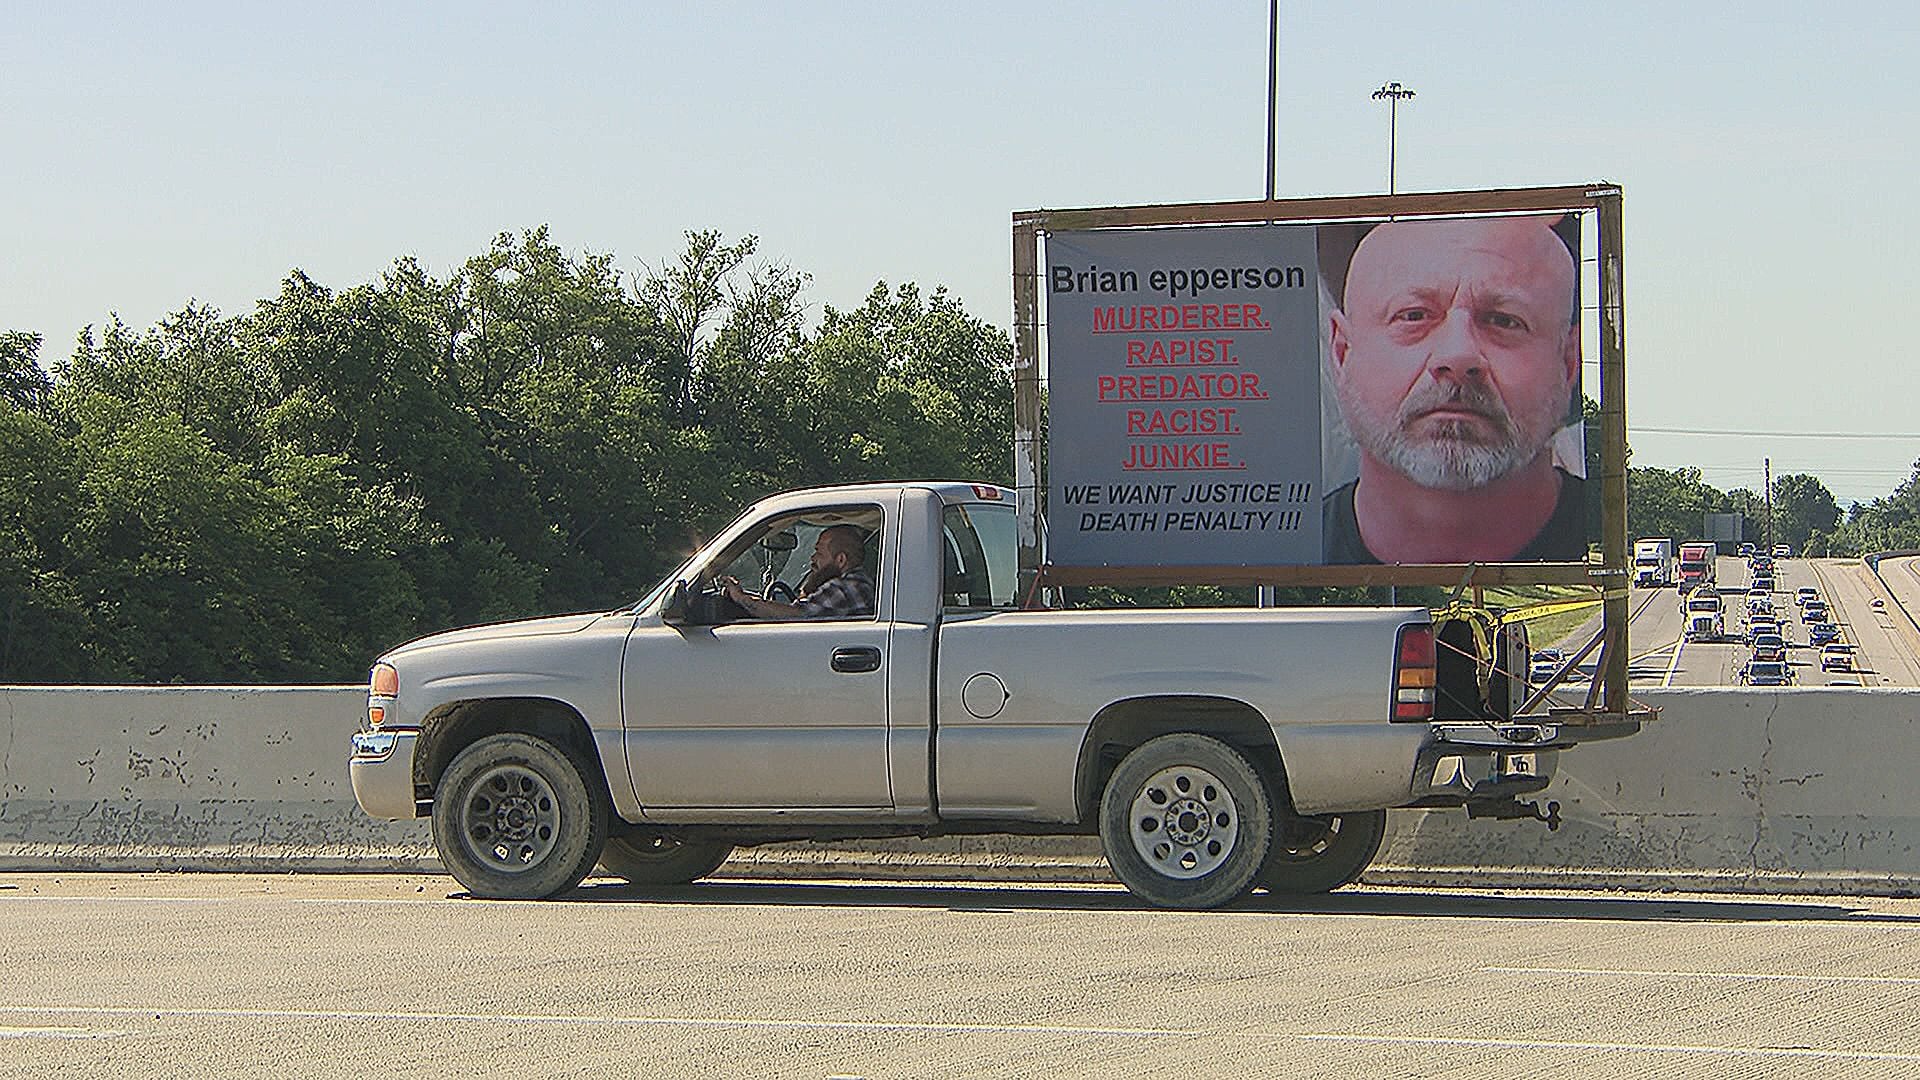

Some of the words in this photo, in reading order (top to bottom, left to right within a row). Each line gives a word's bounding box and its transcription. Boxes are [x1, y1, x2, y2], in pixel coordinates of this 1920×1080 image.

[1052, 265, 1138, 294] Brian
[1149, 266, 1305, 298] epperson
[1093, 303, 1271, 333] MURDERER.
[1126, 339, 1239, 368] RAPIST.
[1098, 373, 1269, 402] PREDATOR.
[1127, 408, 1242, 436] RACIST.
[1063, 485, 1101, 505] WE
[1107, 485, 1177, 504] WANT
[1181, 484, 1282, 504] JUSTICE
[1287, 483, 1312, 503] !!!
[1079, 512, 1158, 532] DEATH
[1163, 511, 1273, 531] PENALTY
[1277, 511, 1302, 531] !!!
